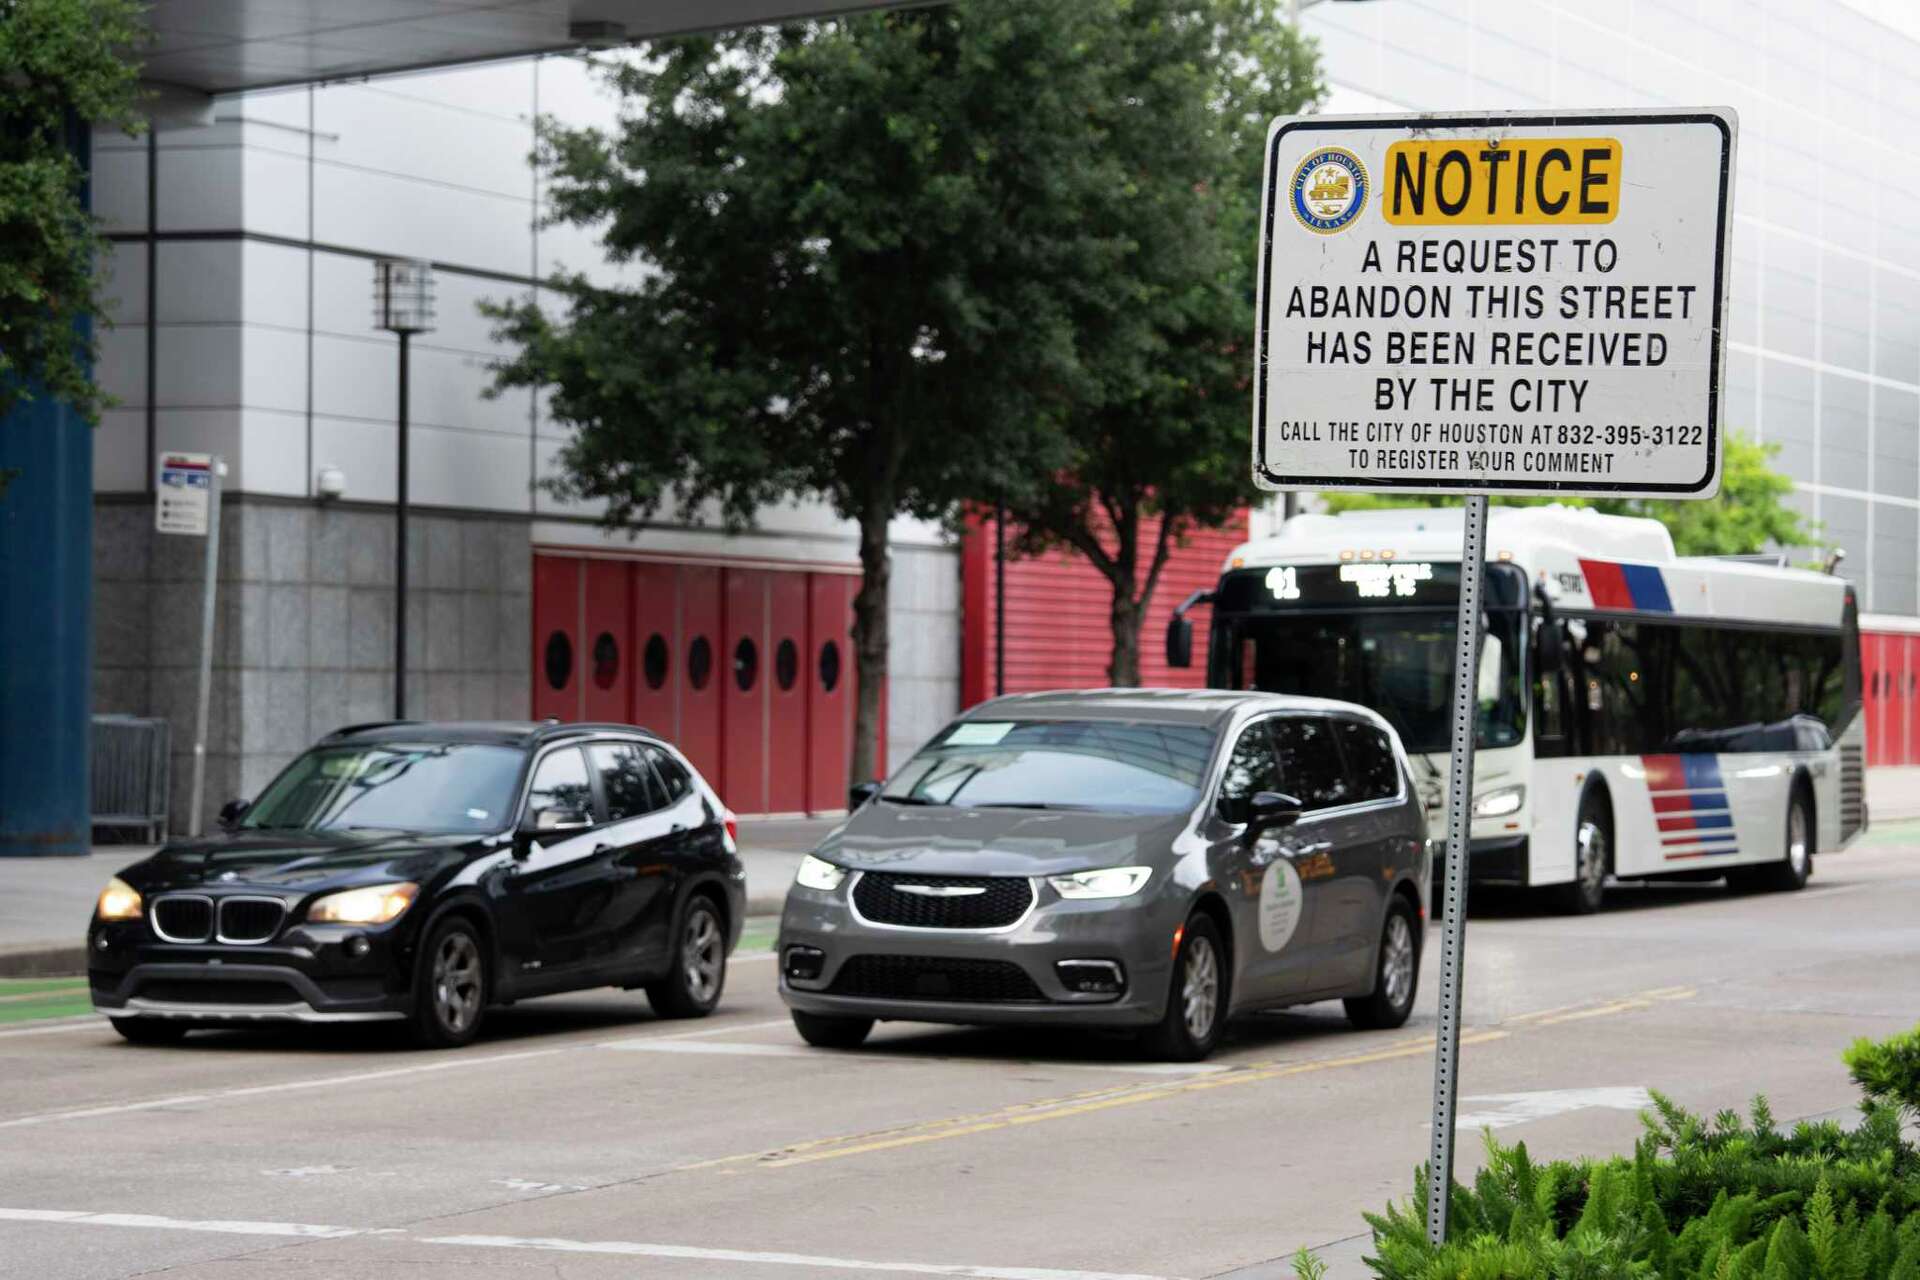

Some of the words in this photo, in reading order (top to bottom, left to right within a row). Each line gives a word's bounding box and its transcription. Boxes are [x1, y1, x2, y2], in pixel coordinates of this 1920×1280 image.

[1295, 166, 1311, 190] CITY
[1312, 155, 1326, 166] OF
[1327, 153, 1364, 188] HOUSTON
[1392, 148, 1612, 217] NOTICE
[1308, 215, 1348, 228] TEXAS
[1361, 240, 1382, 273] A
[1397, 239, 1559, 274] REQUEST
[1572, 239, 1618, 273] TO
[1285, 285, 1451, 319] ABANDON
[1466, 285, 1544, 320] THIS
[1559, 285, 1696, 320] STREET
[1307, 331, 1372, 365] HAS
[1386, 331, 1475, 365] BEEN
[1491, 332, 1668, 367] RECEIVED
[1374, 377, 1417, 411] BY
[1430, 378, 1495, 412] THE
[1510, 378, 1589, 413] CITY
[1281, 421, 1321, 441] CALL
[1328, 421, 1359, 442] THE
[1366, 422, 1404, 442] CITY
[1411, 422, 1432, 443] OF
[1439, 423, 1523, 445] HOUSTON
[1530, 424, 1553, 445] AT
[1557, 424, 1702, 446] 832-395-3122
[1348, 448, 1369, 469] TO
[1377, 449, 1459, 470] REGISTER
[1466, 450, 1515, 472] YOUR
[1523, 451, 1615, 474] COMMENT
